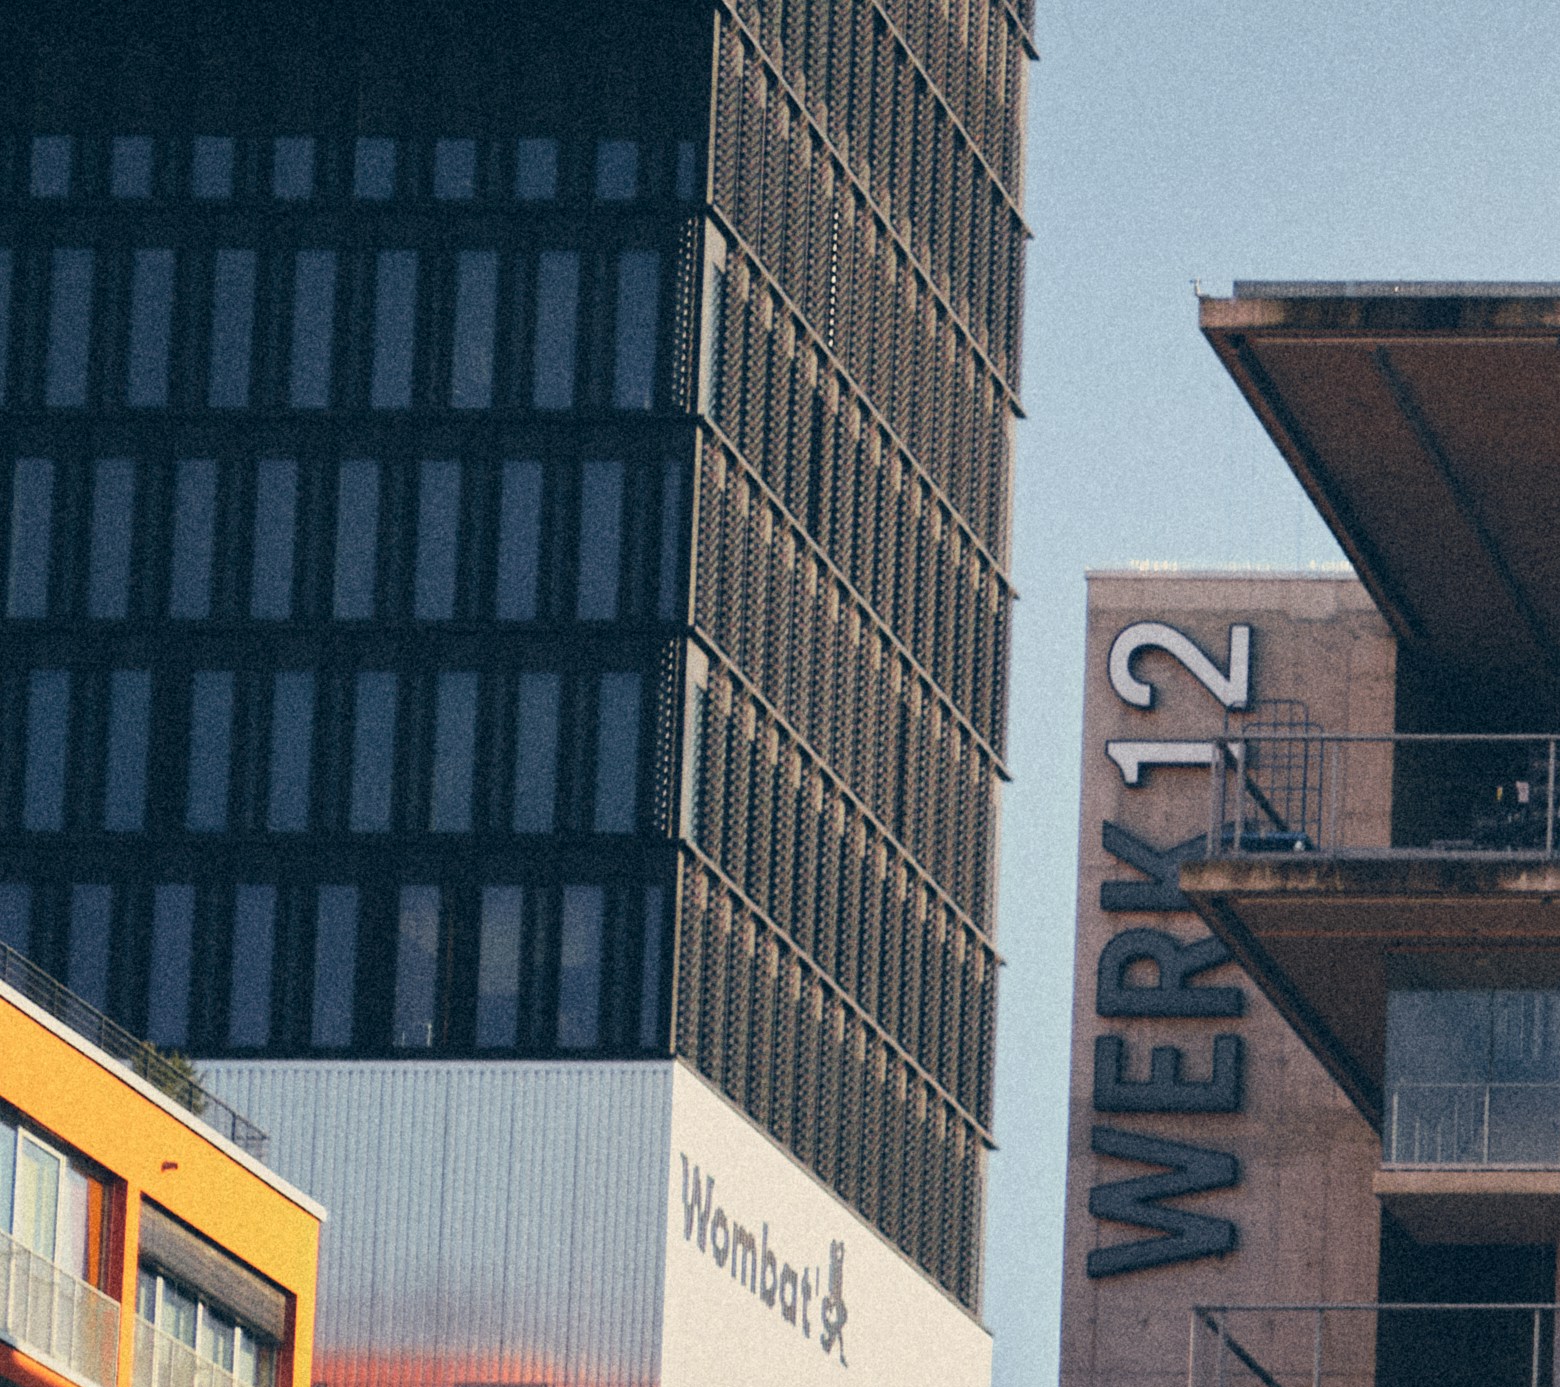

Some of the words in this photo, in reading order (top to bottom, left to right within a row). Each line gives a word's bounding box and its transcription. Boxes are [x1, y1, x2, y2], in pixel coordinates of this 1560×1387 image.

[1106, 621, 1252, 790] 12
[1086, 820, 1247, 1280] WERK
[680, 1151, 848, 1367] Wombat's
